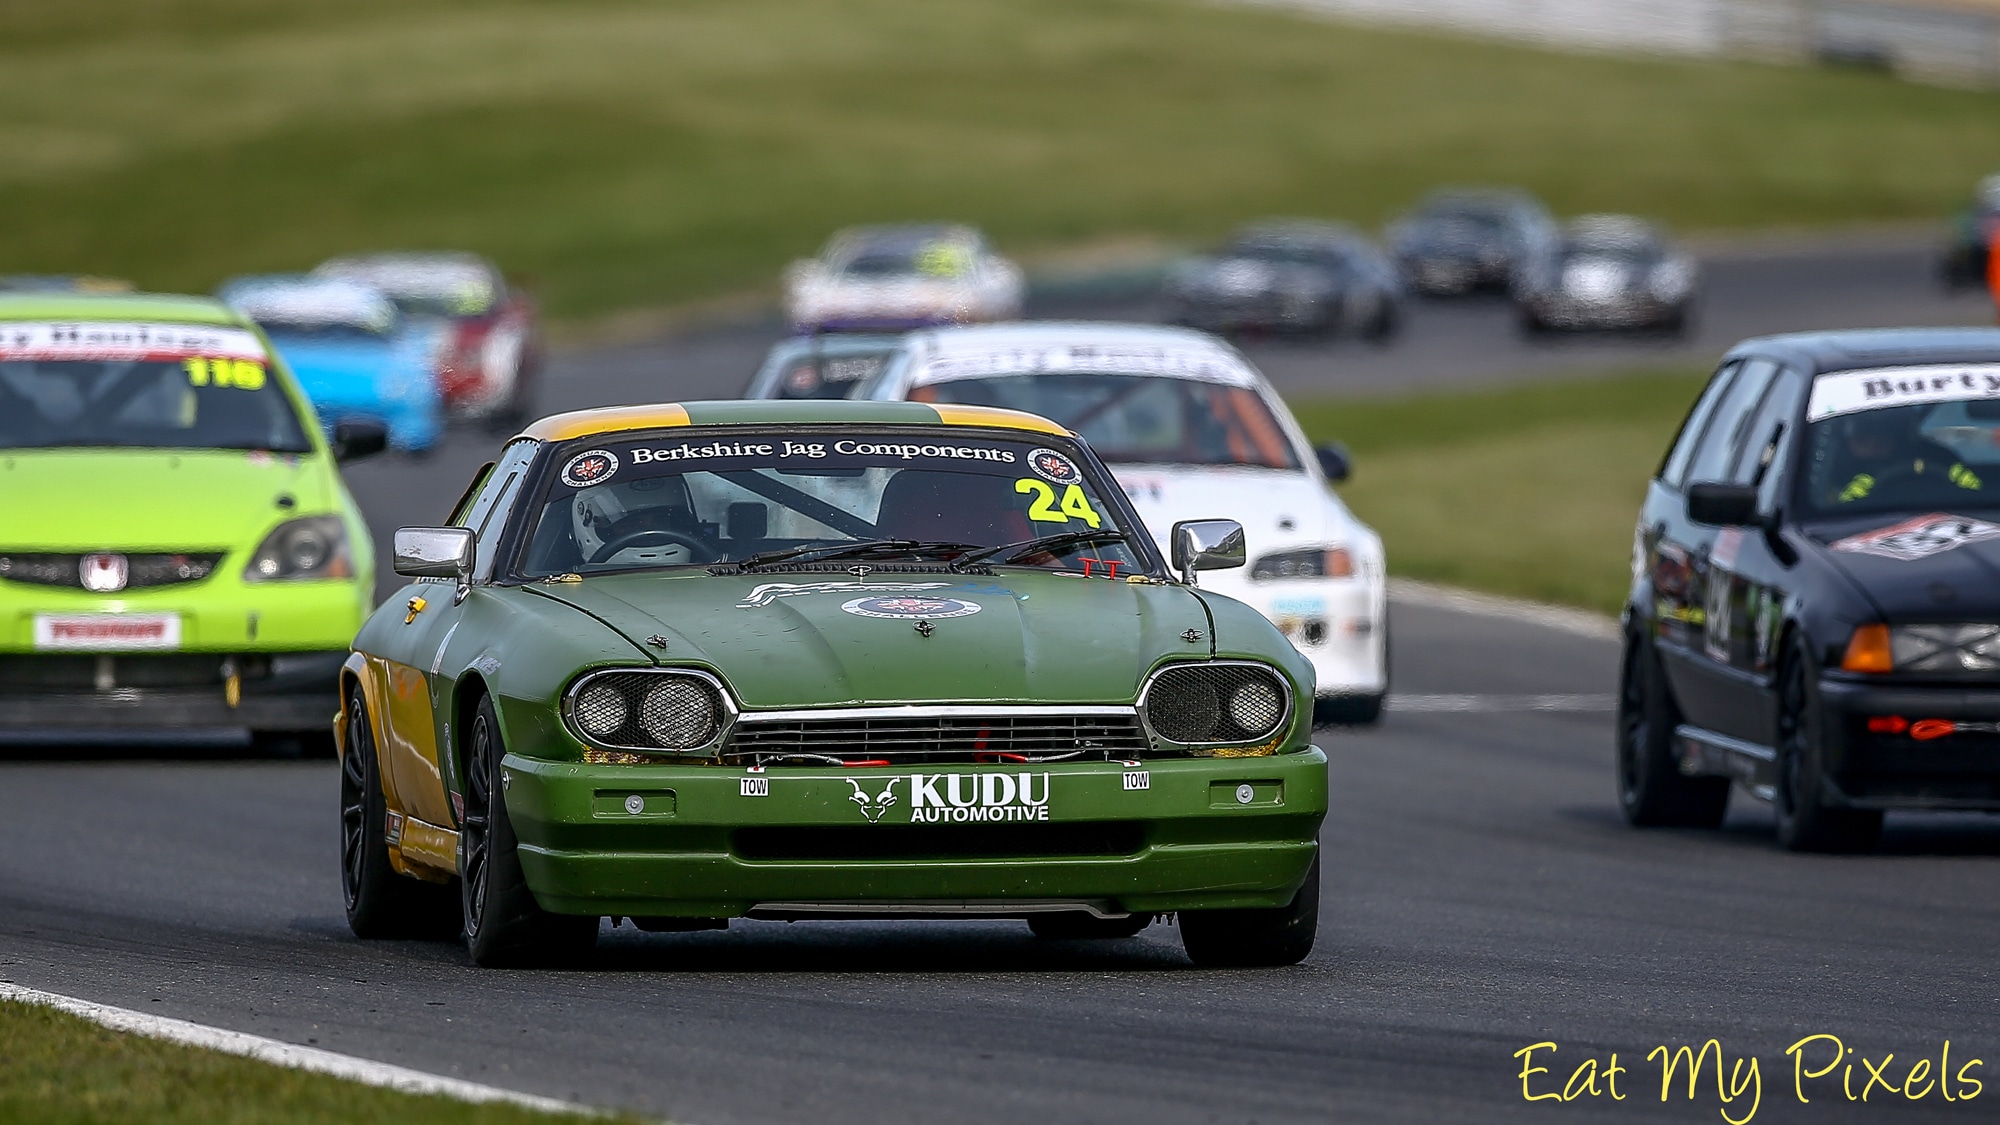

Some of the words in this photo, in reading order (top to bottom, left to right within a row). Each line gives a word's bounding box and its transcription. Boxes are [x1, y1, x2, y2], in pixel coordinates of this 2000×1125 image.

[630, 442, 774, 465] Berkshire
[779, 441, 827, 459] Jag
[833, 440, 1016, 463] Components
[1014, 478, 1101, 529] 24
[742, 778, 768, 795] TOW
[909, 772, 1050, 808] KUDU
[1124, 773, 1149, 789] TOW
[909, 805, 1050, 823] AUTOMOTIVE
